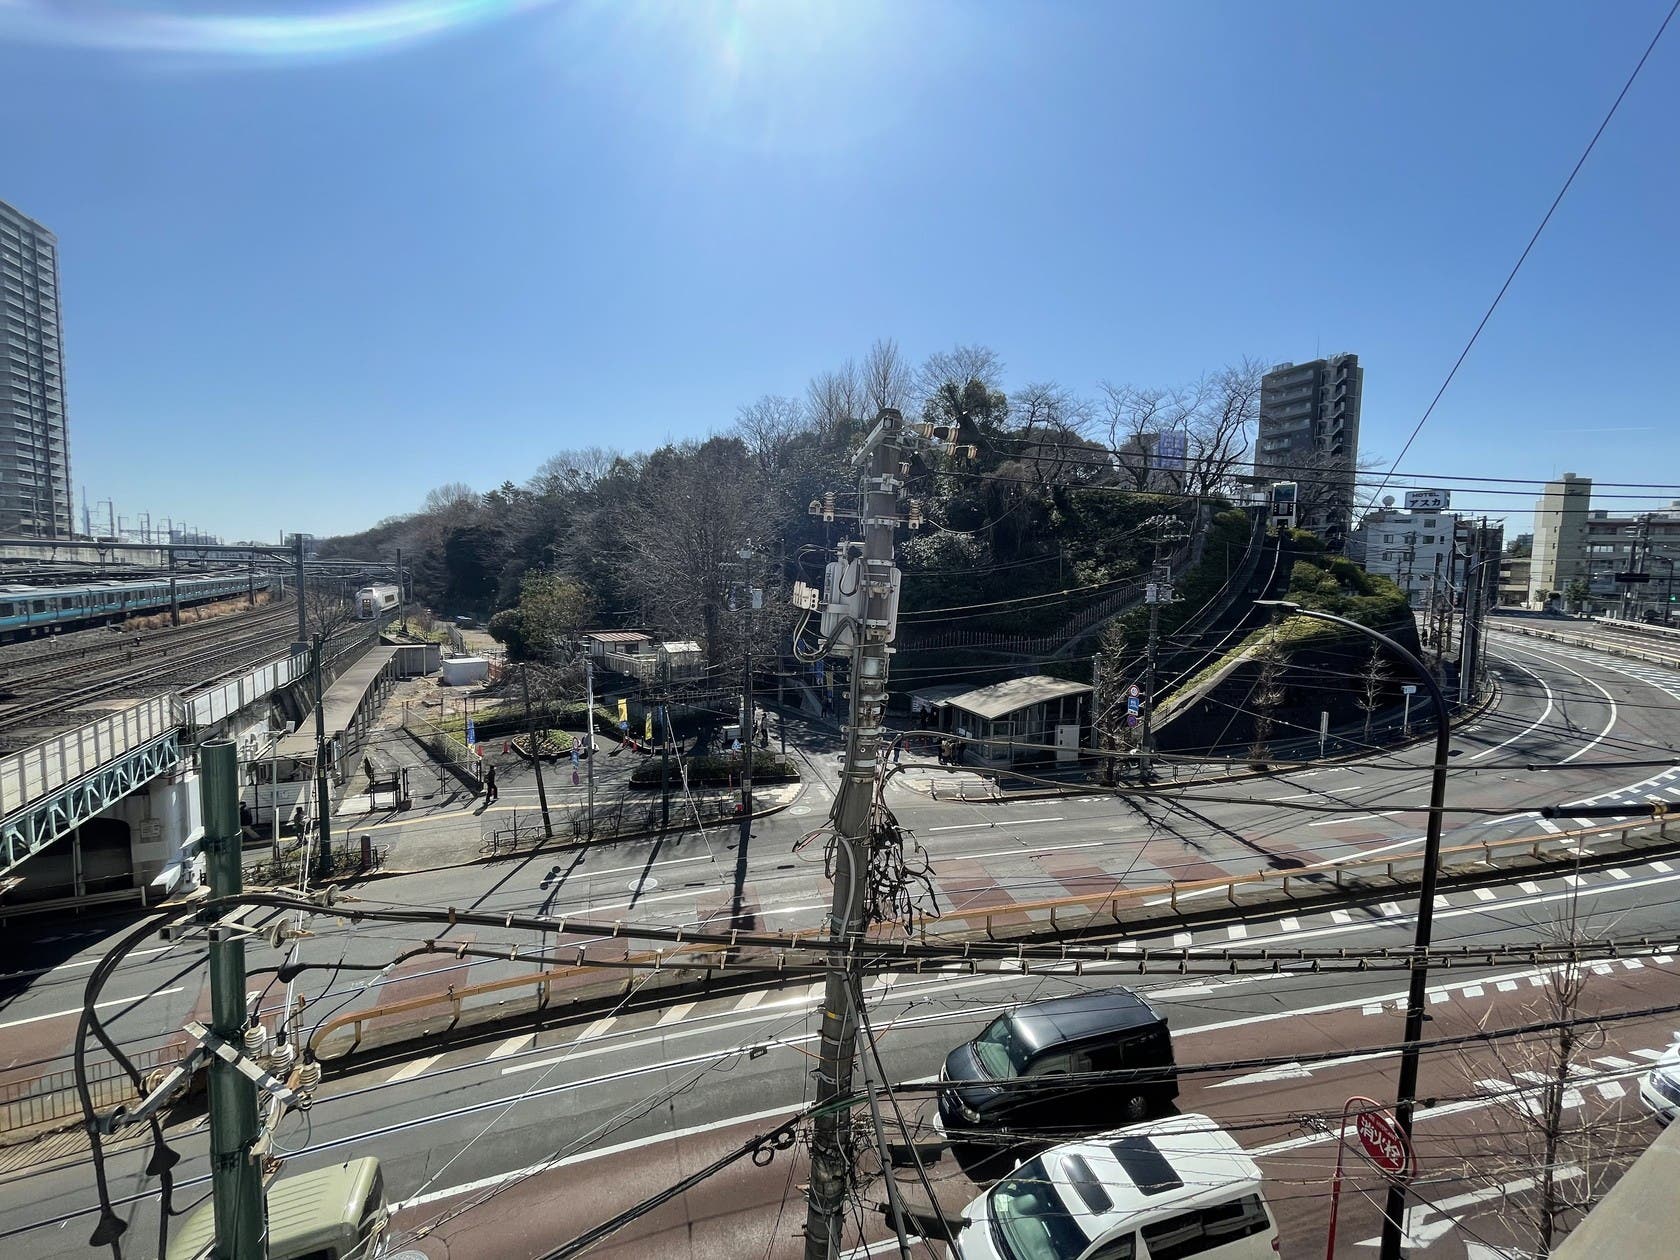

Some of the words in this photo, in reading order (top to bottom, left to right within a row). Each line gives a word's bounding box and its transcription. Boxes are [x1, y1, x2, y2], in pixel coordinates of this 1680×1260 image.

[1409, 499, 1441, 507] アスカ
[1360, 1115, 1401, 1167] 消火栓
